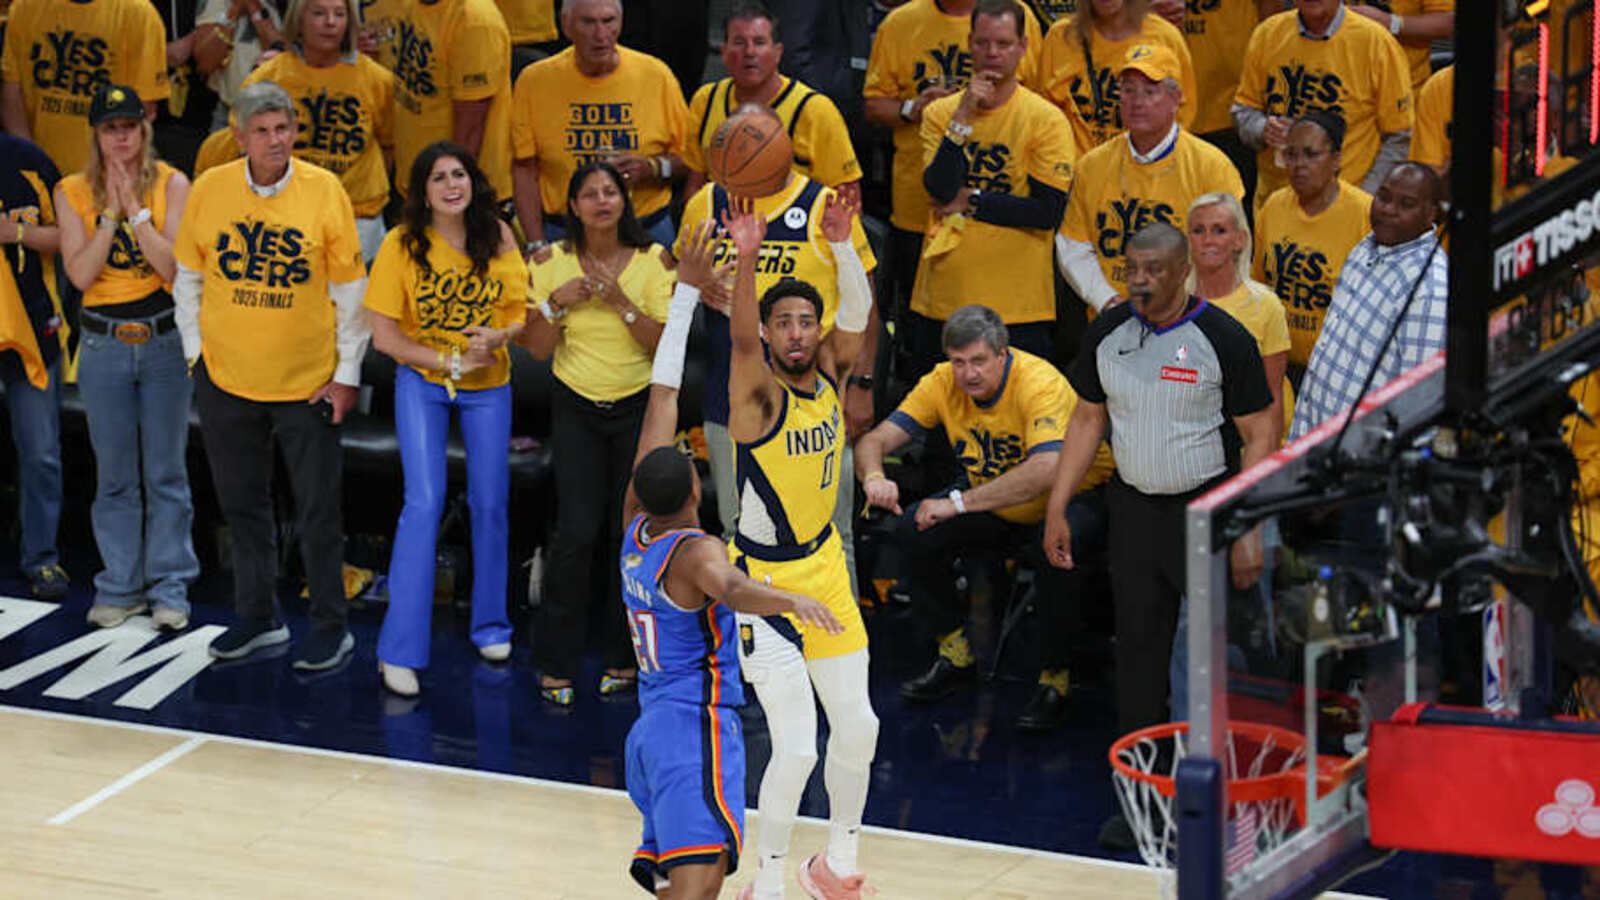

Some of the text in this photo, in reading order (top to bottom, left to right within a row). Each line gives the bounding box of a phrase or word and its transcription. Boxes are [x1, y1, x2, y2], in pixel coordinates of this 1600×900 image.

[46, 30, 108, 67] YES
[930, 44, 974, 83] YE
[1281, 65, 1342, 103] YES
[301, 93, 361, 126] YES
[570, 104, 633, 125] GOLD
[562, 130, 641, 151] DON'T
[236, 220, 305, 257] YES
[712, 241, 801, 274] PAERS
[1274, 243, 1328, 282] YES
[232, 287, 295, 309] 2025 FINALS
[415, 271, 504, 307] BOOM
[820, 450, 835, 490] 0
